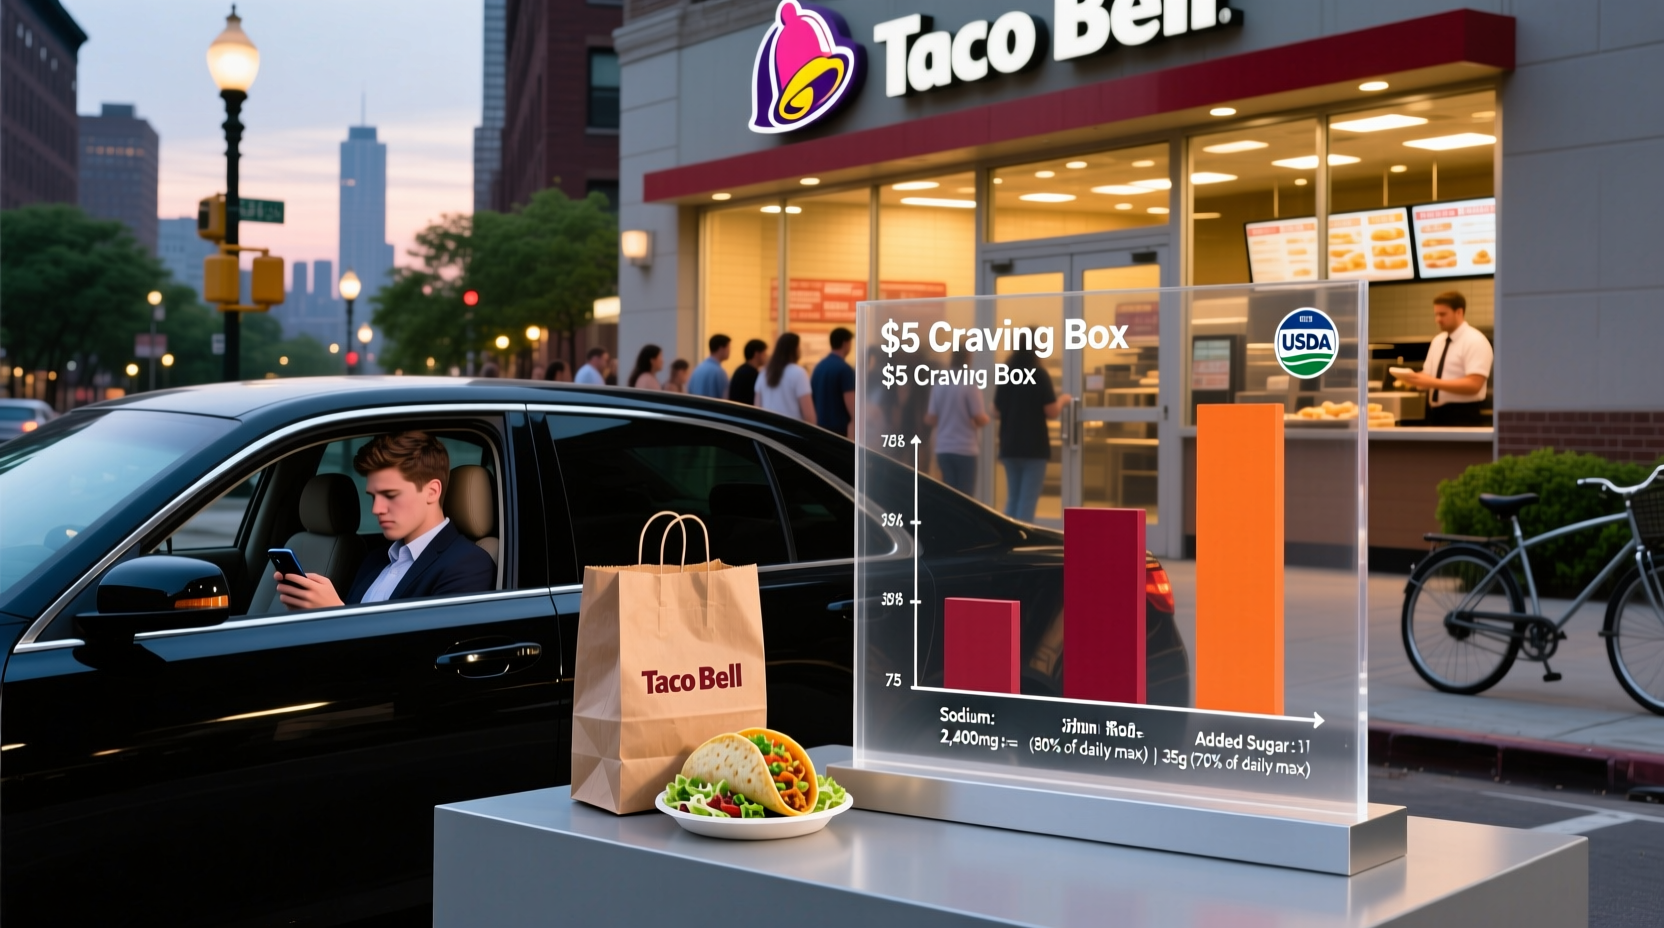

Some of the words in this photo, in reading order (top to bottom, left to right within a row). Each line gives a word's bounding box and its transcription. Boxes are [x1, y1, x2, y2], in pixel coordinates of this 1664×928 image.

[873, 11, 1036, 98] Taco
[880, 318, 921, 358] $5
[928, 318, 1055, 358] Craving
[1064, 318, 1130, 350] Box
[1282, 333, 1332, 351] USDA
[881, 362, 908, 390] $5
[994, 363, 1037, 385] Box
[641, 670, 696, 695] Taco
[698, 662, 743, 691] Bell
[885, 672, 902, 687] 75
[939, 706, 996, 726] Sodium:
[939, 728, 999, 751] 2,400mg
[1064, 738, 1078, 755] of
[1079, 740, 1112, 761] daily
[1114, 745, 1149, 765] max)
[1162, 748, 1188, 770] 35g
[1190, 751, 1223, 770] (70%
[1225, 754, 1239, 771] of
[1241, 756, 1274, 777] daily
[1275, 761, 1311, 780] max)
[1194, 731, 1243, 750] Added
